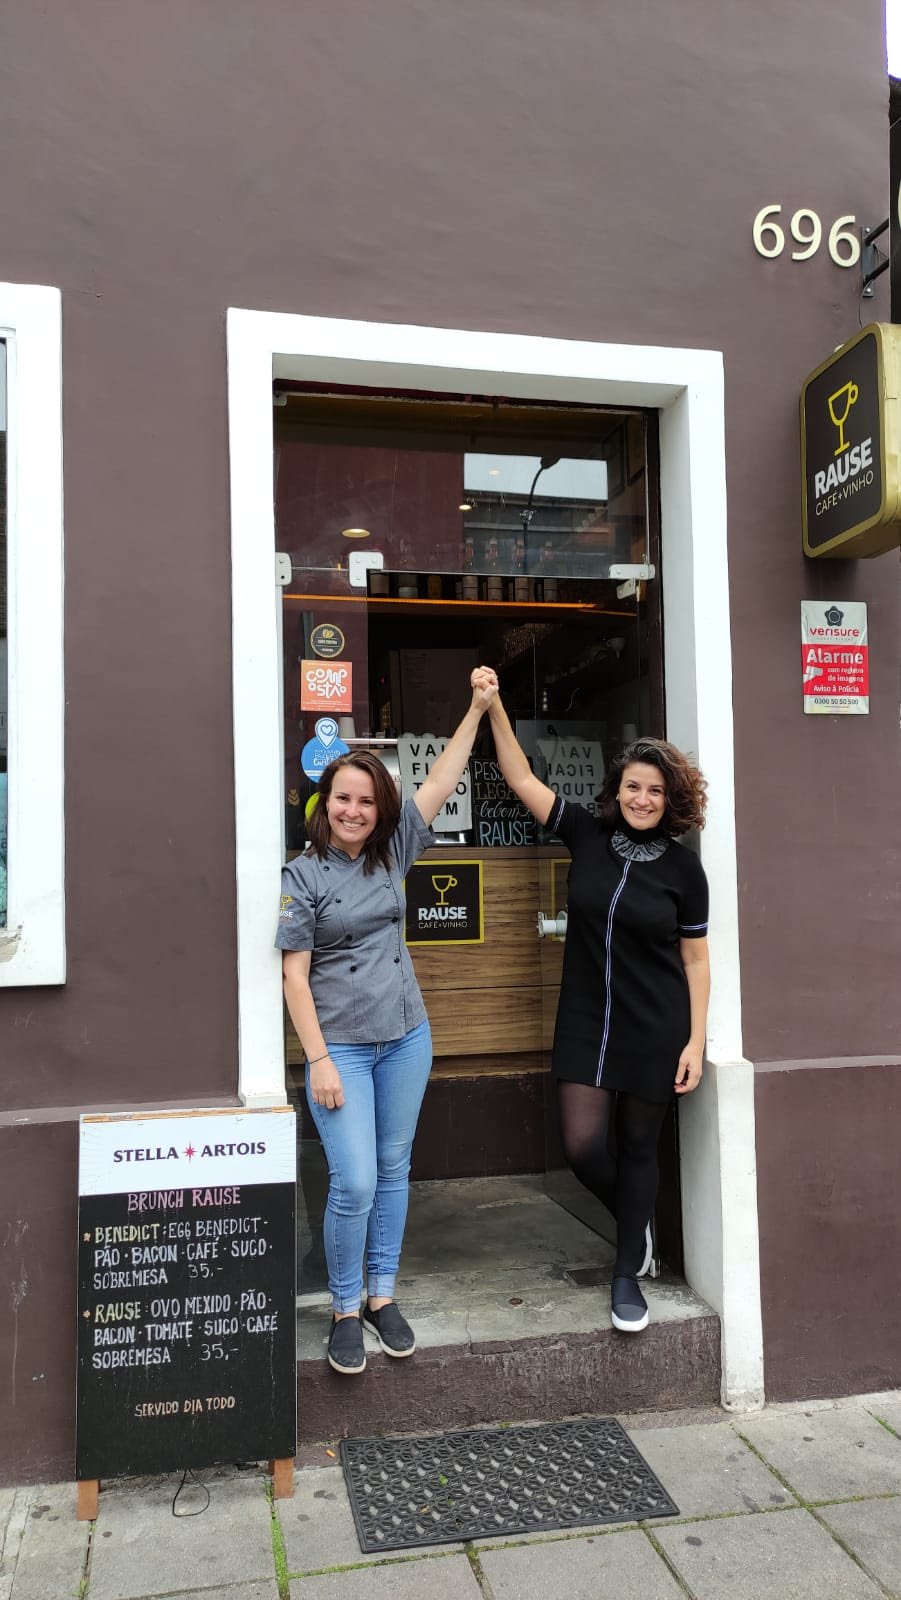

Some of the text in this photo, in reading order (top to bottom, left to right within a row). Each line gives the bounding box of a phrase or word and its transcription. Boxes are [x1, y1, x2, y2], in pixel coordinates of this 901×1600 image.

[752, 204, 861, 268] 696
[814, 437, 873, 499] RAUSE
[809, 627, 860, 637] verisure
[807, 648, 864, 664] Alarme
[479, 820, 534, 847] RAUSE
[418, 906, 467, 921] RAUSE
[113, 1141, 266, 1163] STELLA ARTOIS
[127, 1186, 241, 1212] BRUNCH RAUSE
[94, 1245, 120, 1267] PÃO
[131, 1244, 178, 1265] BACON
[231, 1238, 267, 1257] SUCO
[93, 1268, 169, 1290] SOBREMESA
[151, 1298, 180, 1318] OVO
[185, 1294, 231, 1315] MEXIDO
[240, 1289, 267, 1311] PÃO
[94, 1326, 136, 1347] BACON
[145, 1321, 194, 1341] TOMATE
[204, 1318, 239, 1336] SUCO
[92, 1347, 172, 1369] SOBREMESA
[135, 1396, 236, 1417] SERVIDO DIA TODO
